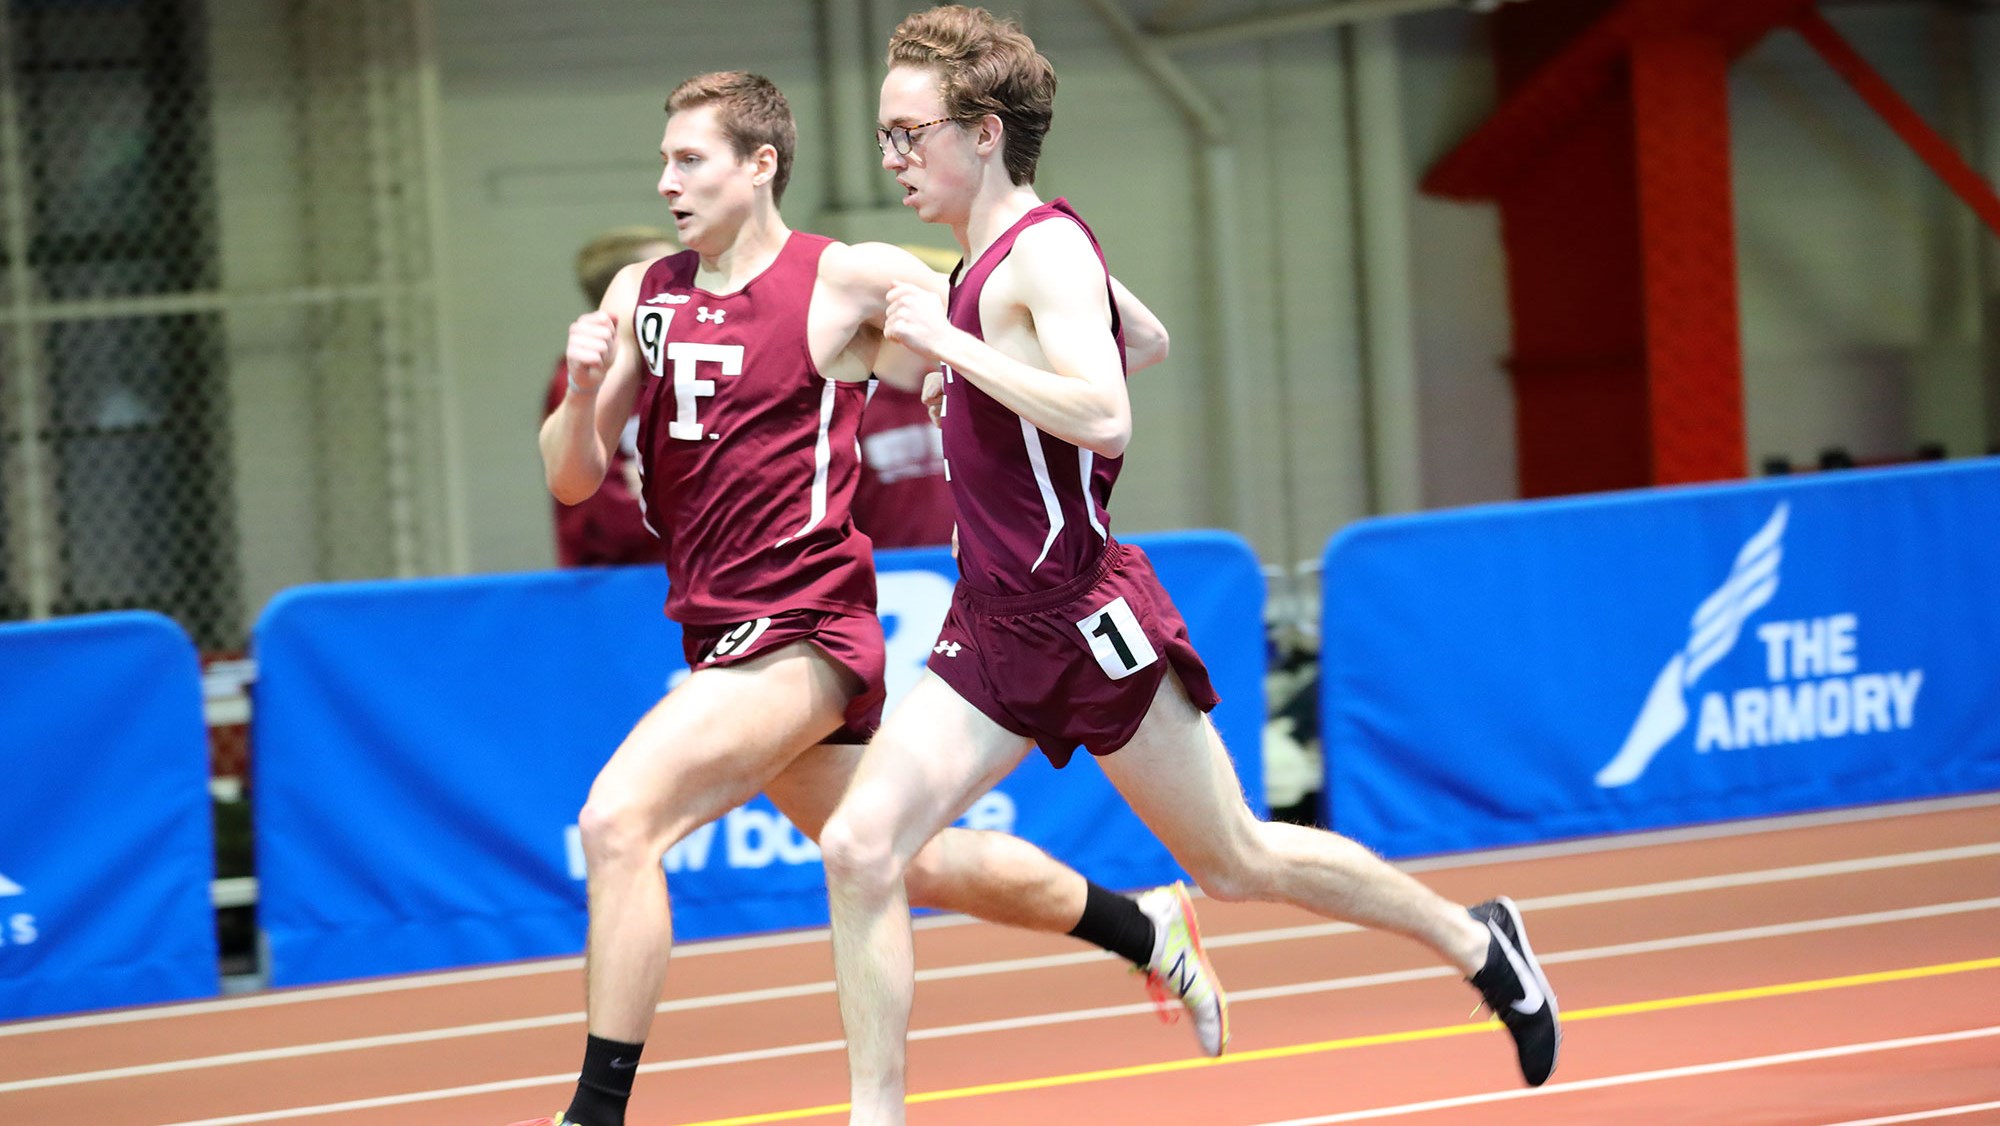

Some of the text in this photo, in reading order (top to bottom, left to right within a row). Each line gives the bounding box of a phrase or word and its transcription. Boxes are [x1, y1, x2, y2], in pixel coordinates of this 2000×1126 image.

[642, 312, 663, 371] 9
[667, 342, 745, 440] F
[712, 619, 757, 657] 9
[1092, 612, 1138, 670] 1
[1757, 613, 1858, 682] THE
[1695, 669, 1923, 752] ARMORY
